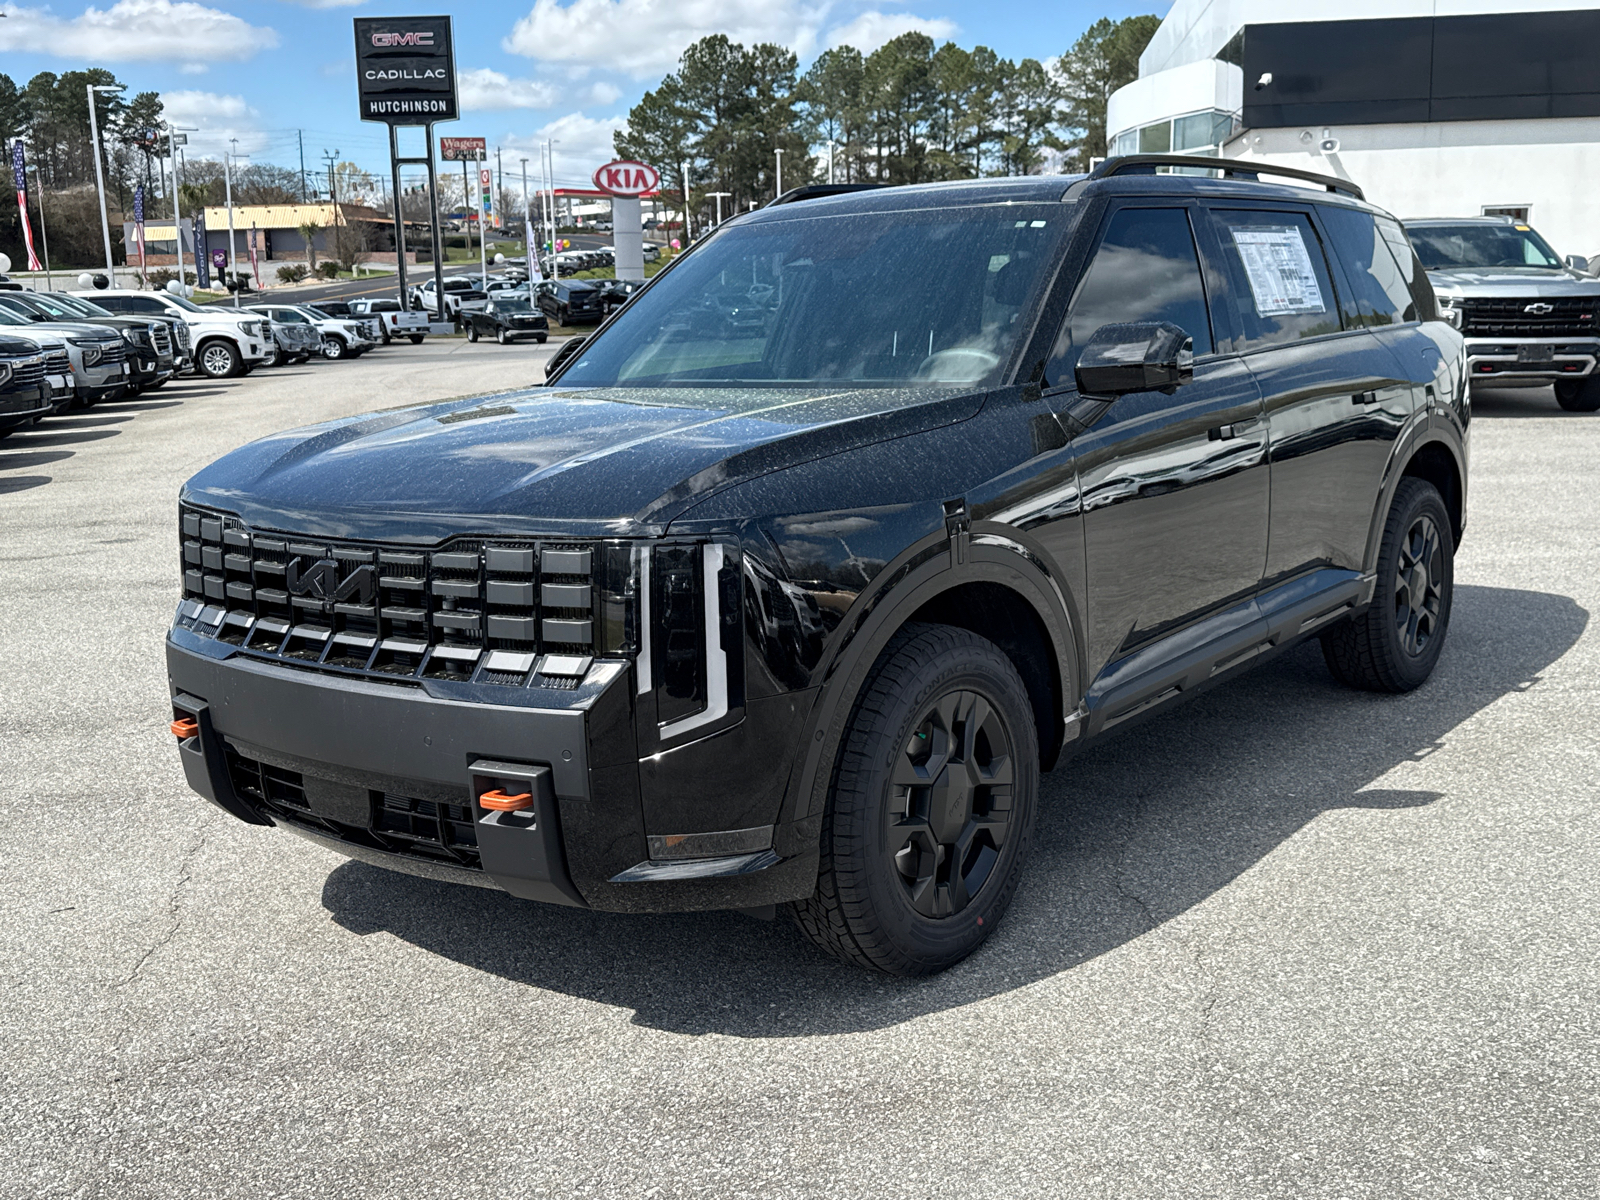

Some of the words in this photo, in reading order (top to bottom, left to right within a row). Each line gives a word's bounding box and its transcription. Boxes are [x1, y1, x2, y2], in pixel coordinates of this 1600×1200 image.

[371, 31, 435, 47] GMC
[365, 68, 446, 80] CADILLAC
[370, 100, 447, 113] HUTCHINSON
[606, 168, 649, 188] KIA
[196, 223, 206, 285] CADILLAC
[286, 556, 376, 604] KIA
